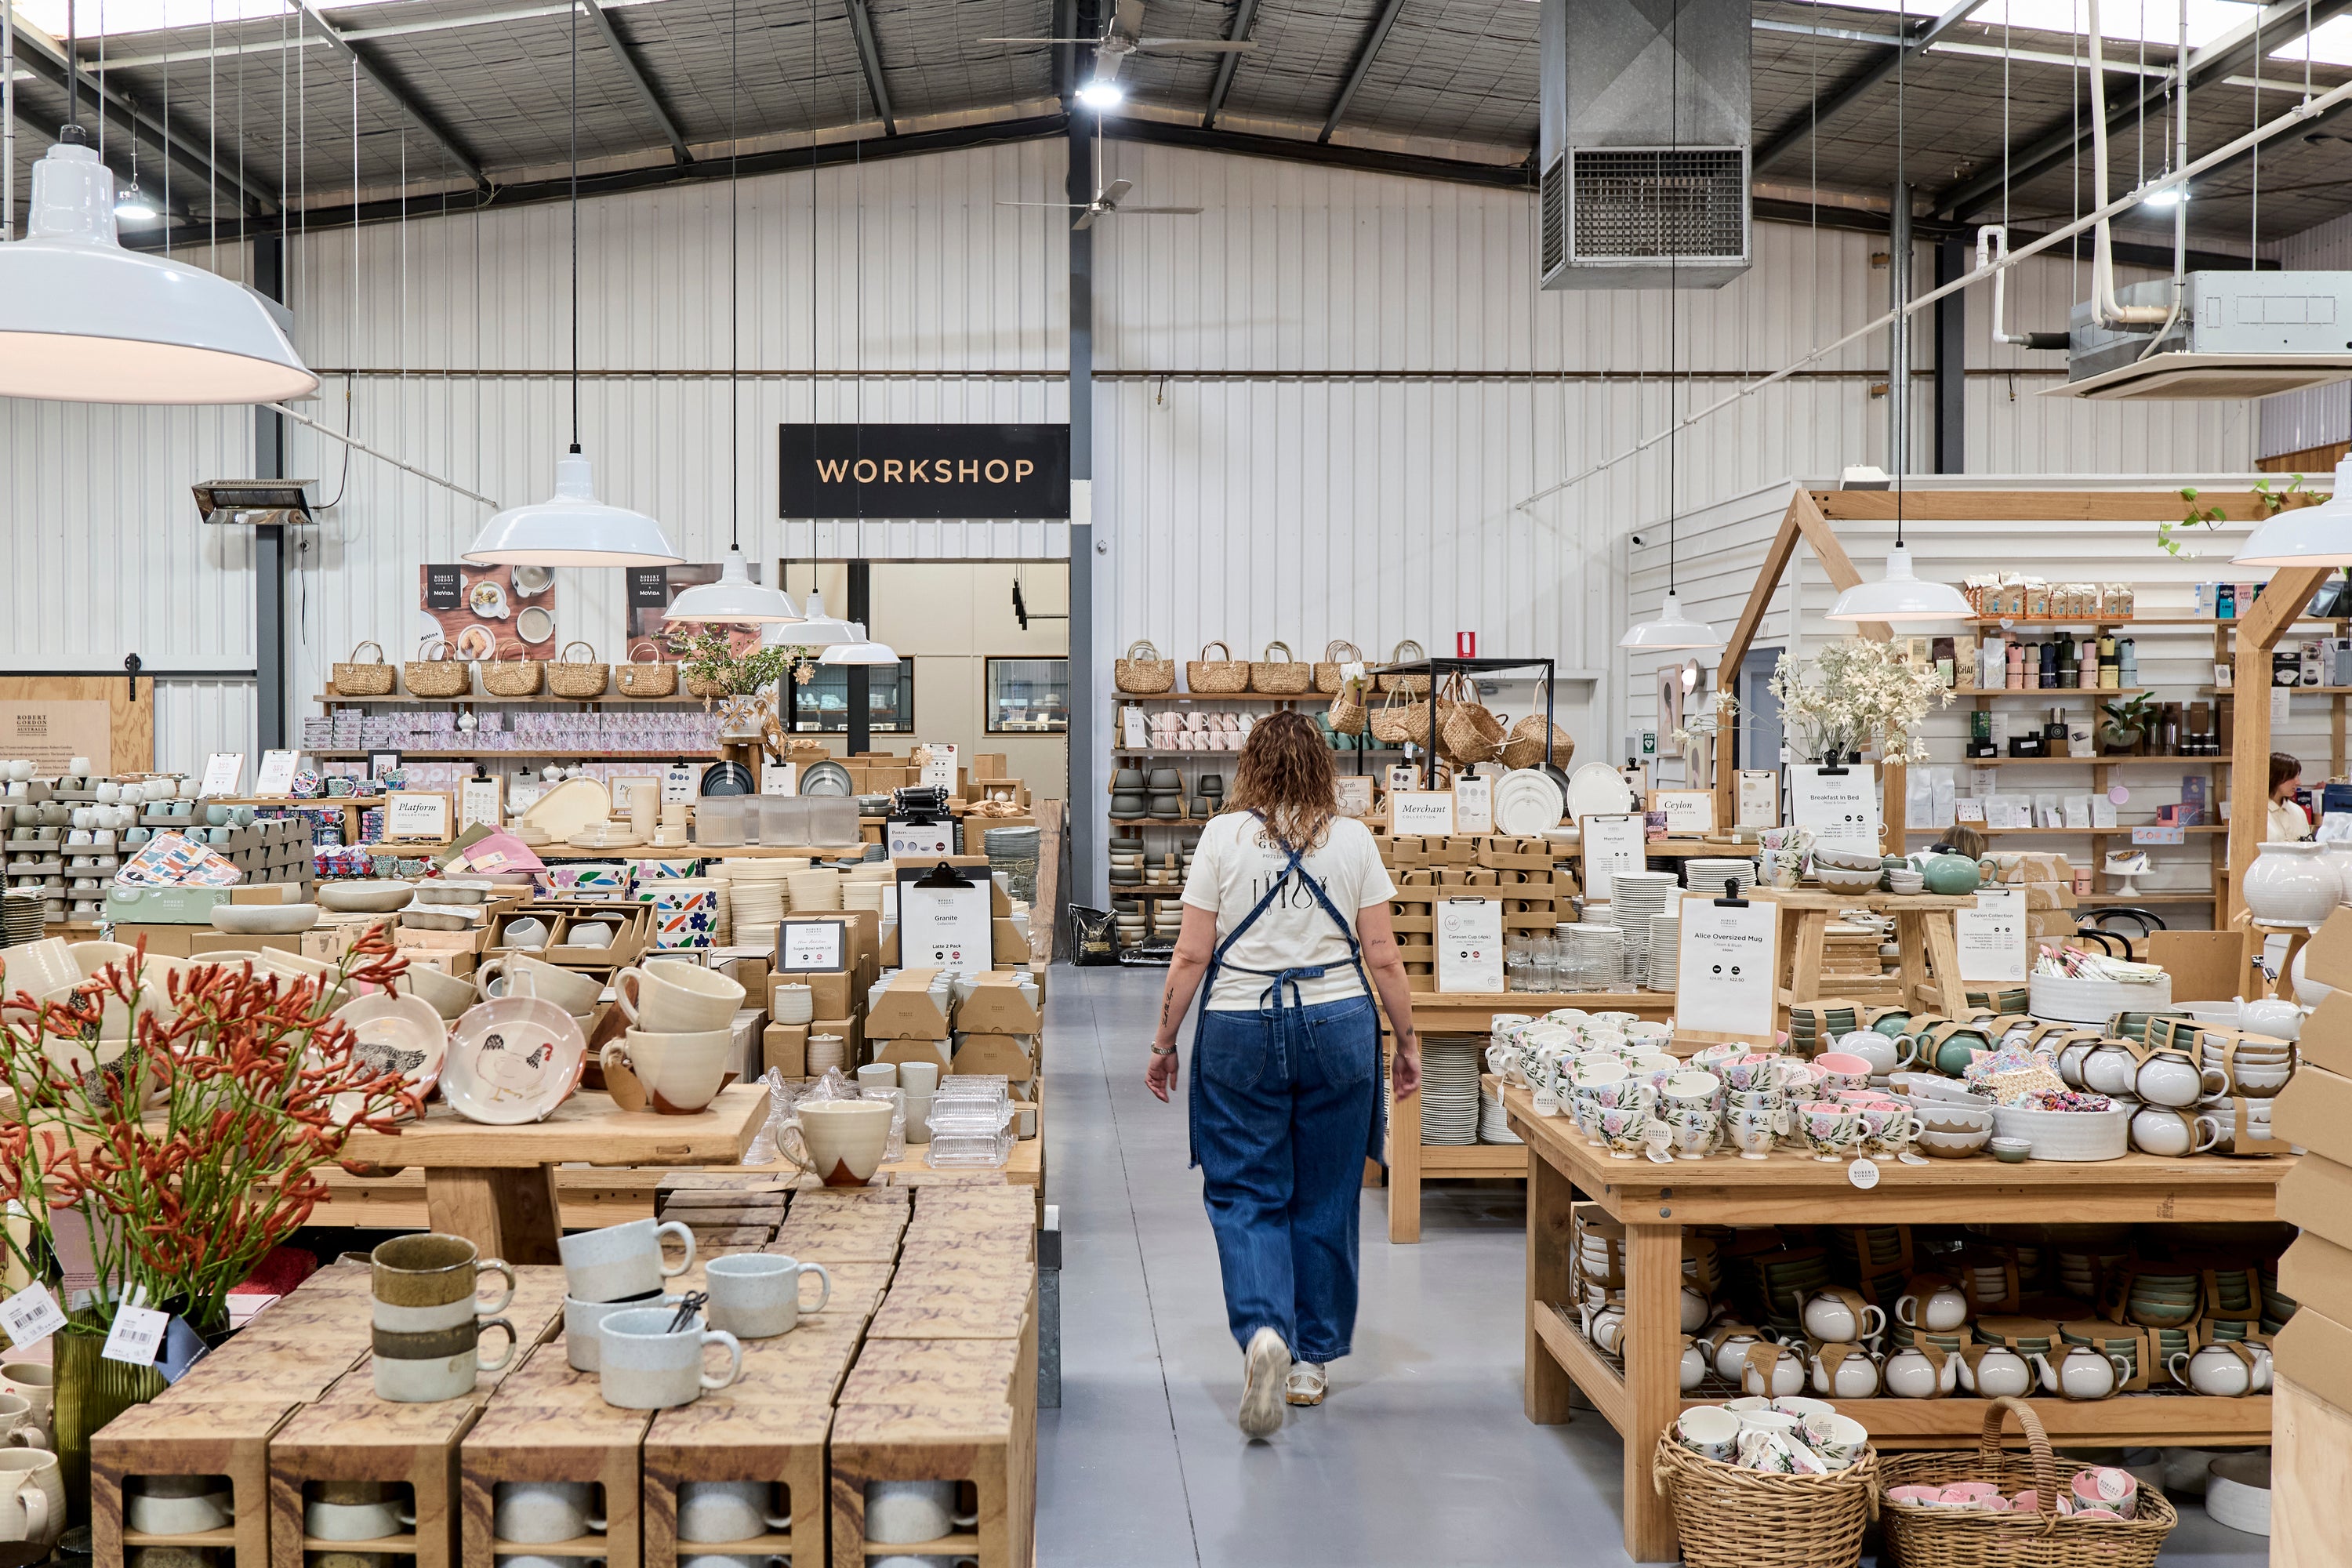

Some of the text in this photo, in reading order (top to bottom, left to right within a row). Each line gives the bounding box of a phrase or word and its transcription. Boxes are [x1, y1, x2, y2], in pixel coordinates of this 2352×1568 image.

[816, 459, 1034, 484] WORKSHOP
[1957, 666, 1973, 674] CHAI
[398, 802, 437, 814] Platform
[1402, 804, 1446, 814] Merchant
[1664, 800, 1693, 811] Ceylon
[2100, 1483, 2117, 1496] GORDON
[2101, 1479, 2119, 1493] ROBERT
